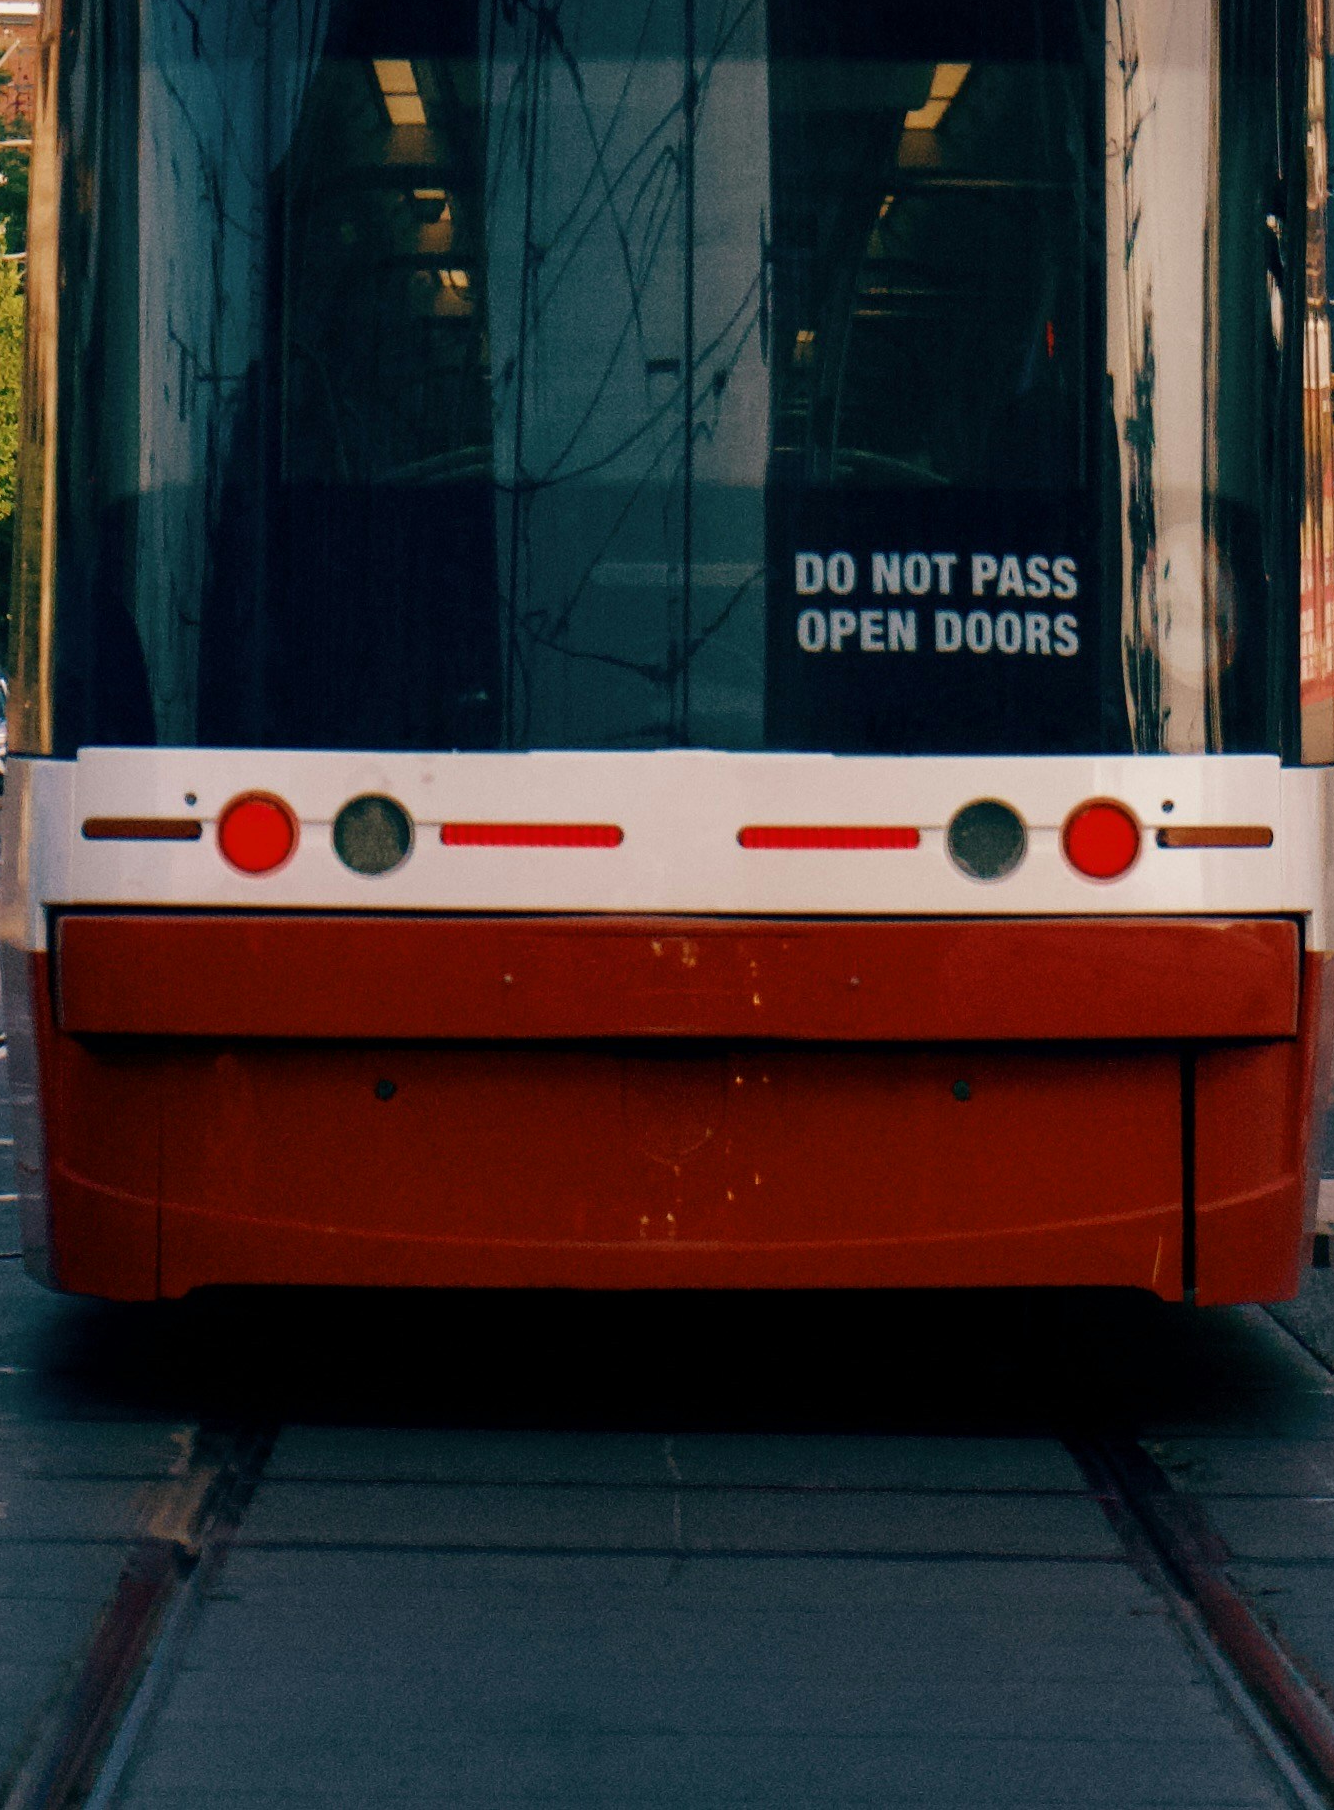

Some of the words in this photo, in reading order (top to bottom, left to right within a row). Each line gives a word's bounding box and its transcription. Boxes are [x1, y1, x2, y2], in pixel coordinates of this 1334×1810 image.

[794, 551, 856, 596] DO
[871, 551, 959, 596] NOT
[971, 552, 1079, 600] PASS
[796, 607, 917, 653] OPEN
[934, 608, 1080, 657] DOORS
